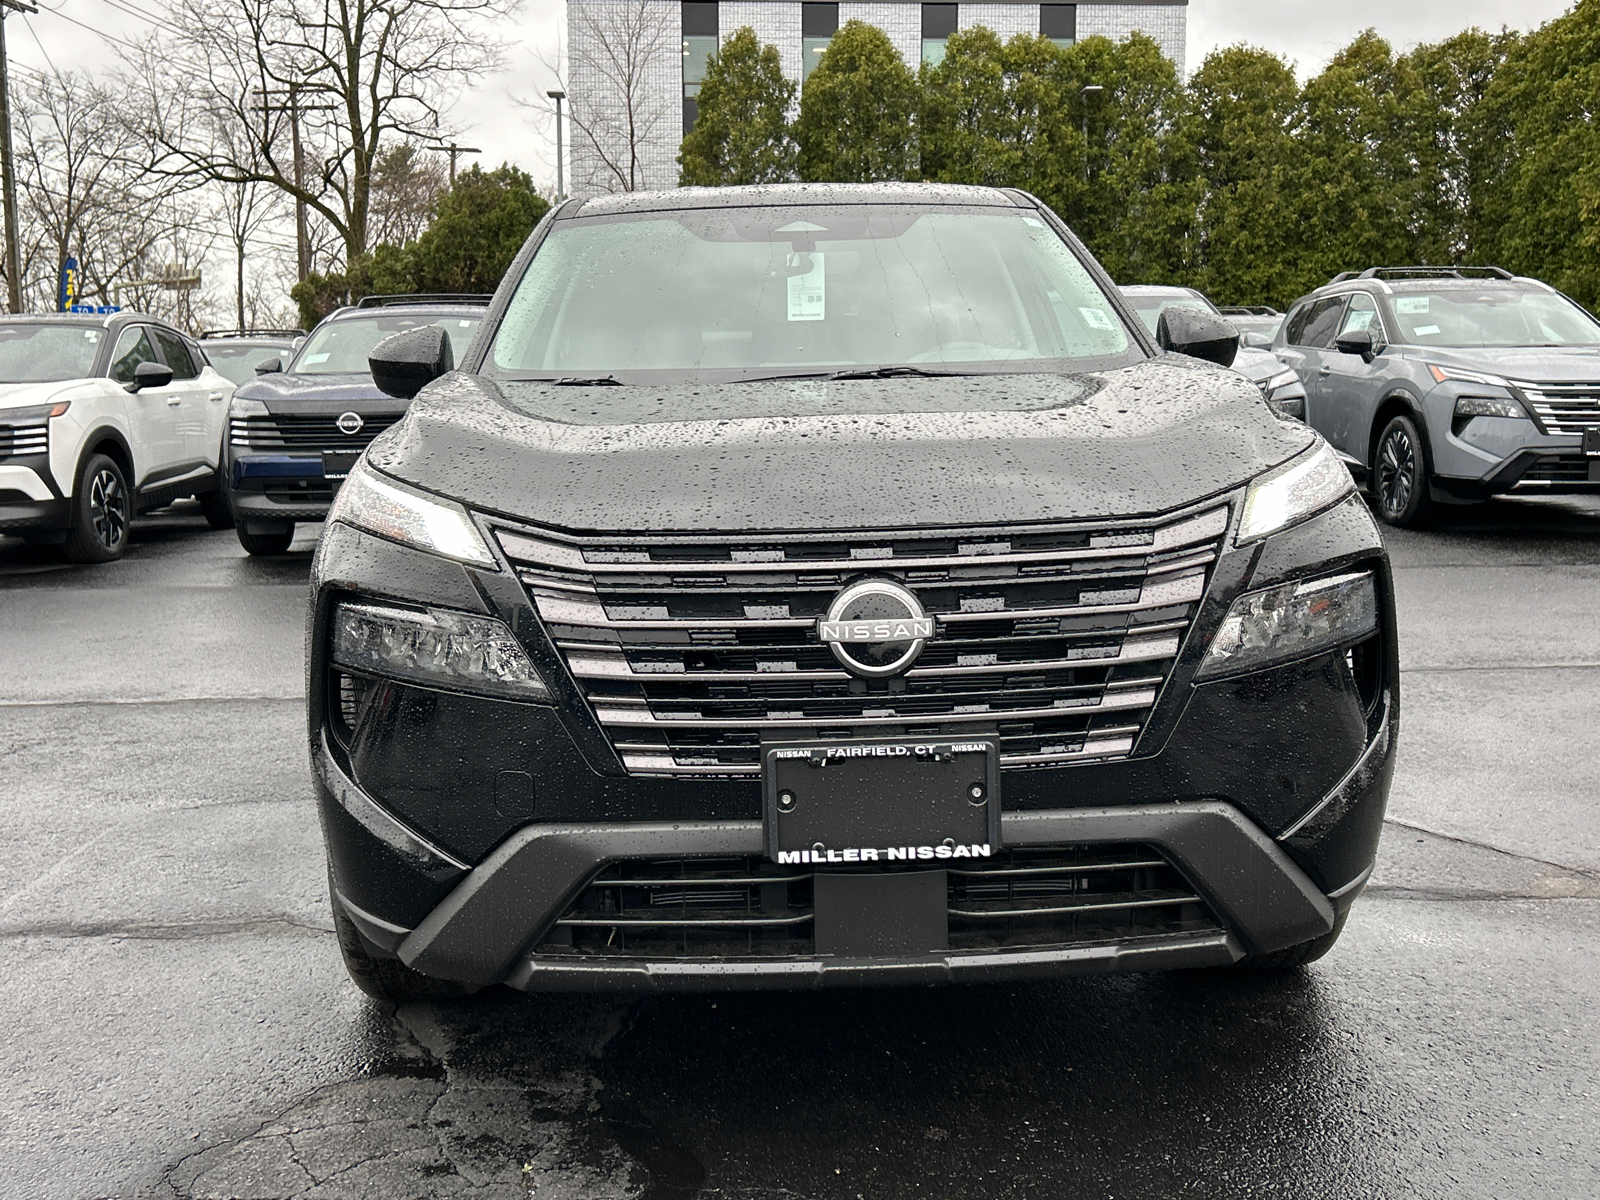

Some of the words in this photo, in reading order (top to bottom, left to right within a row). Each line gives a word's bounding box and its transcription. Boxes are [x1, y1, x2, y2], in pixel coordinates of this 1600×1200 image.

[823, 622, 930, 639] NISSAN
[826, 745, 911, 757] FAIRFIELD,
[915, 745, 936, 755] CT
[951, 743, 986, 752] NISSAN
[776, 750, 812, 759] NISSAN
[777, 848, 879, 864] MILLER
[887, 844, 991, 860] NISSAN
